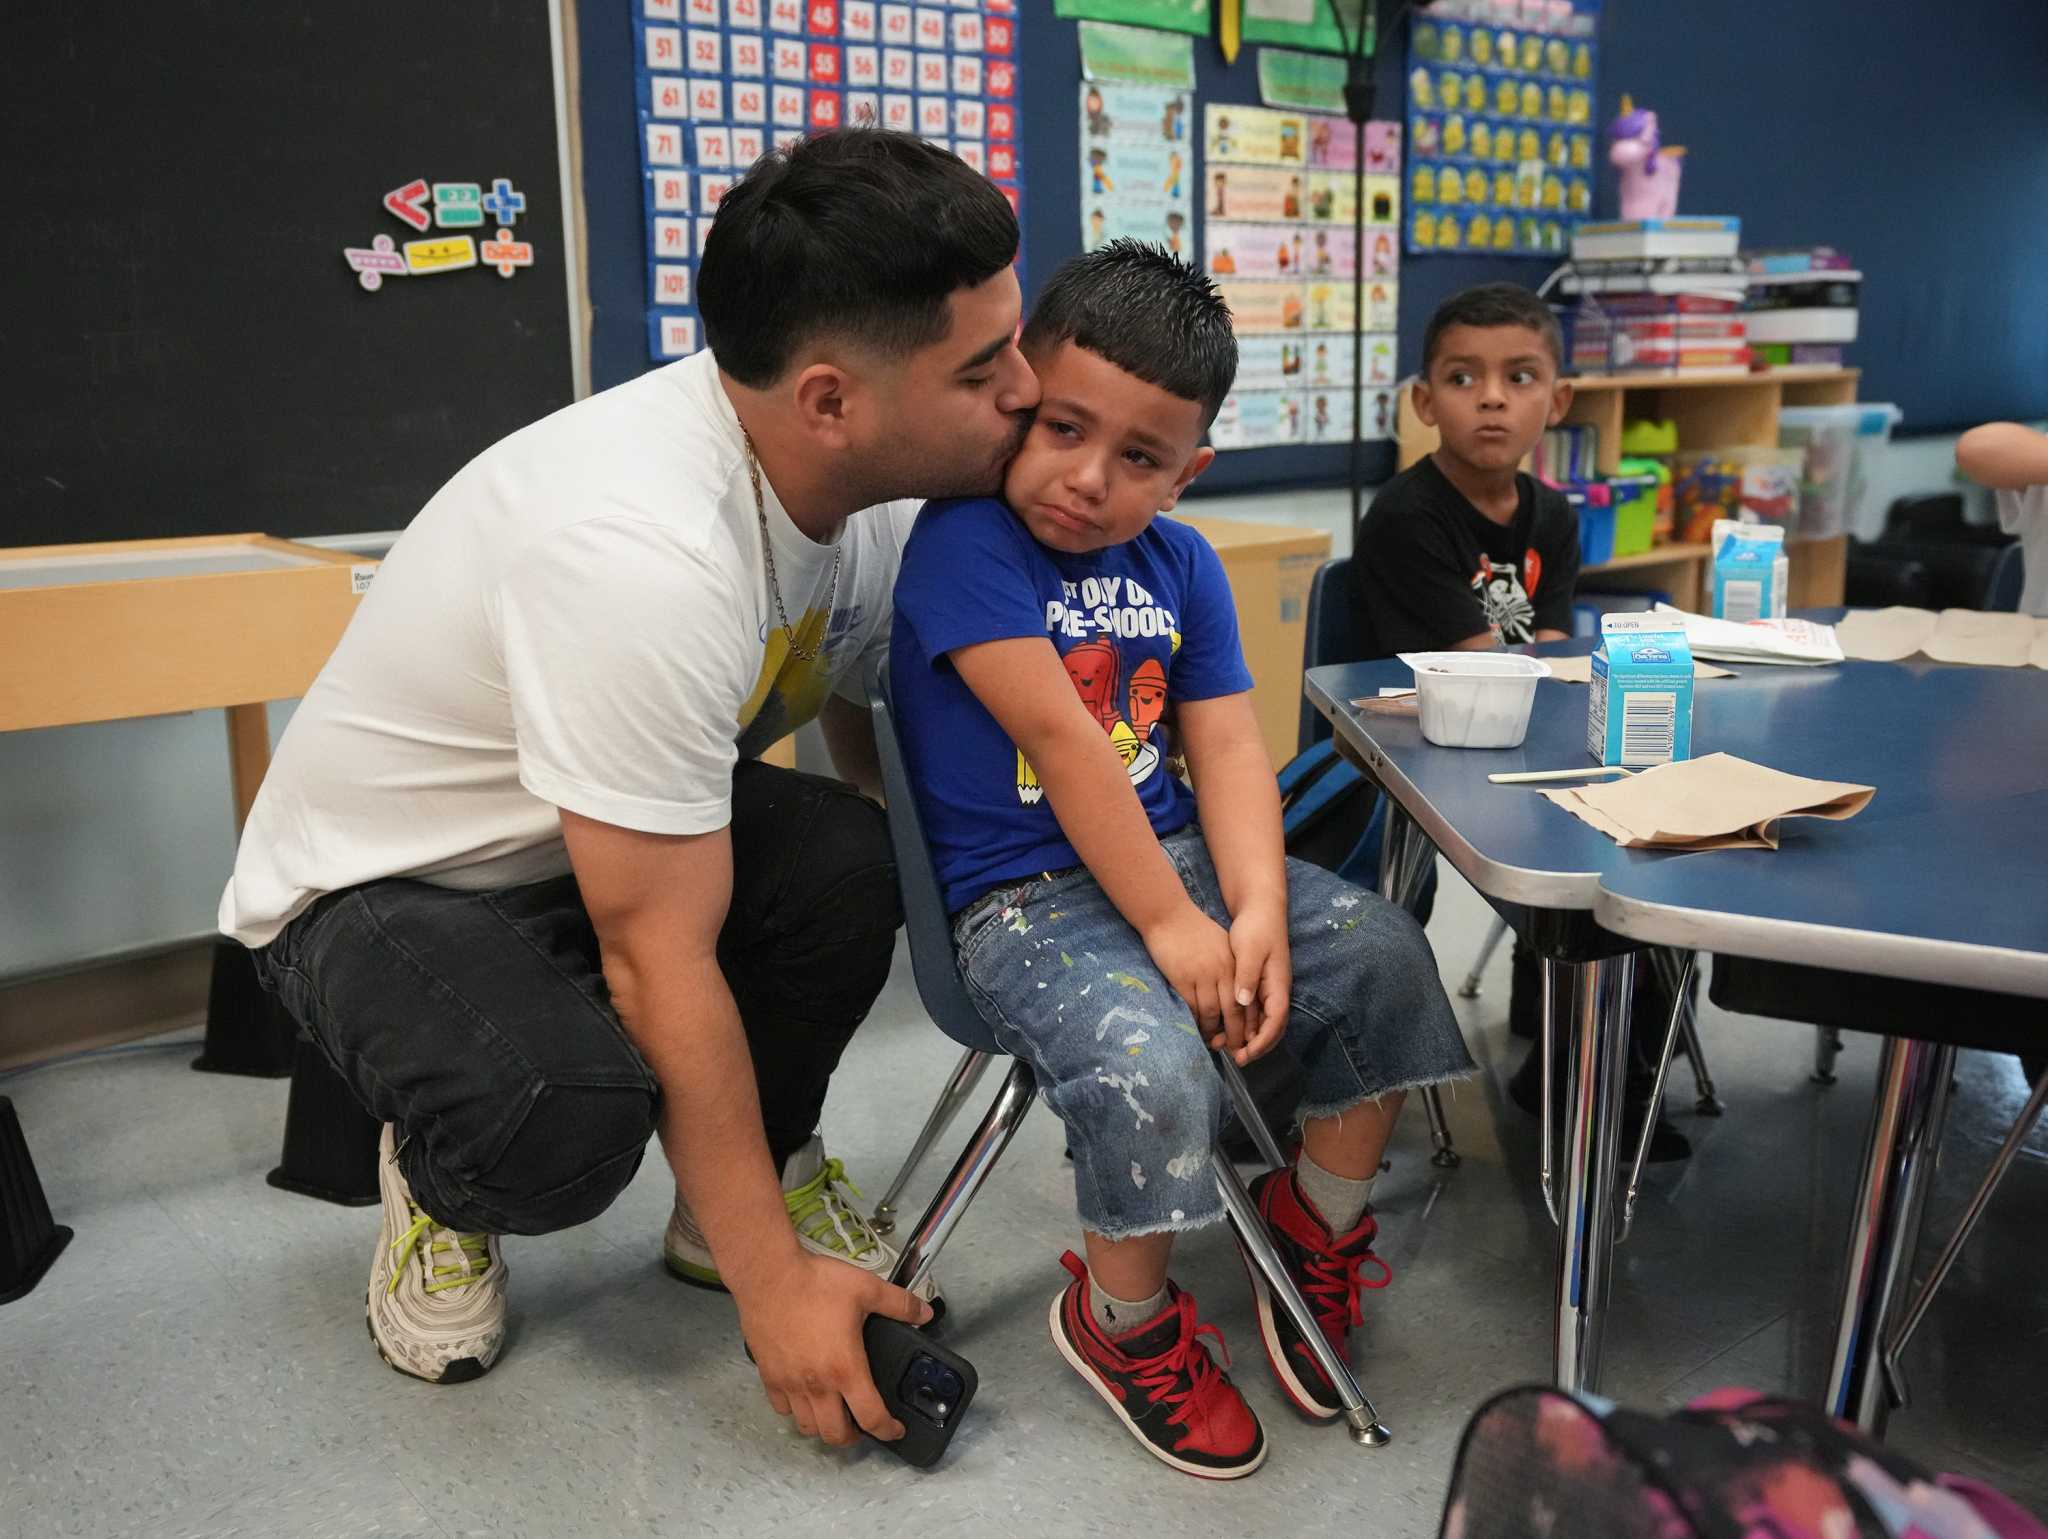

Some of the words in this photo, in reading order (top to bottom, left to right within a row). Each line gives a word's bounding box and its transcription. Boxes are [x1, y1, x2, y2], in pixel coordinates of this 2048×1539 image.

[776, 2, 796, 21] 44
[851, 10, 870, 30] 46
[889, 14, 906, 33] 47
[656, 37, 672, 58] 51
[696, 40, 714, 61] 52
[739, 45, 757, 65] 53
[782, 49, 799, 68] 54
[815, 53, 835, 74] 55
[854, 56, 872, 75] 56
[890, 58, 906, 77] 57
[924, 63, 941, 81] 58
[960, 66, 976, 84] 59
[662, 87, 679, 107] 61
[697, 88, 716, 109] 62
[739, 93, 759, 113] 63
[778, 96, 798, 114] 64
[890, 103, 907, 122] 67
[657, 134, 673, 155] 71
[703, 136, 722, 157] 72
[738, 137, 757, 158] 73
[664, 179, 680, 200] 81
[664, 226, 680, 247] 91
[664, 274, 684, 294] 101
[671, 327, 688, 346] 111
[1126, 578, 1154, 606] O
